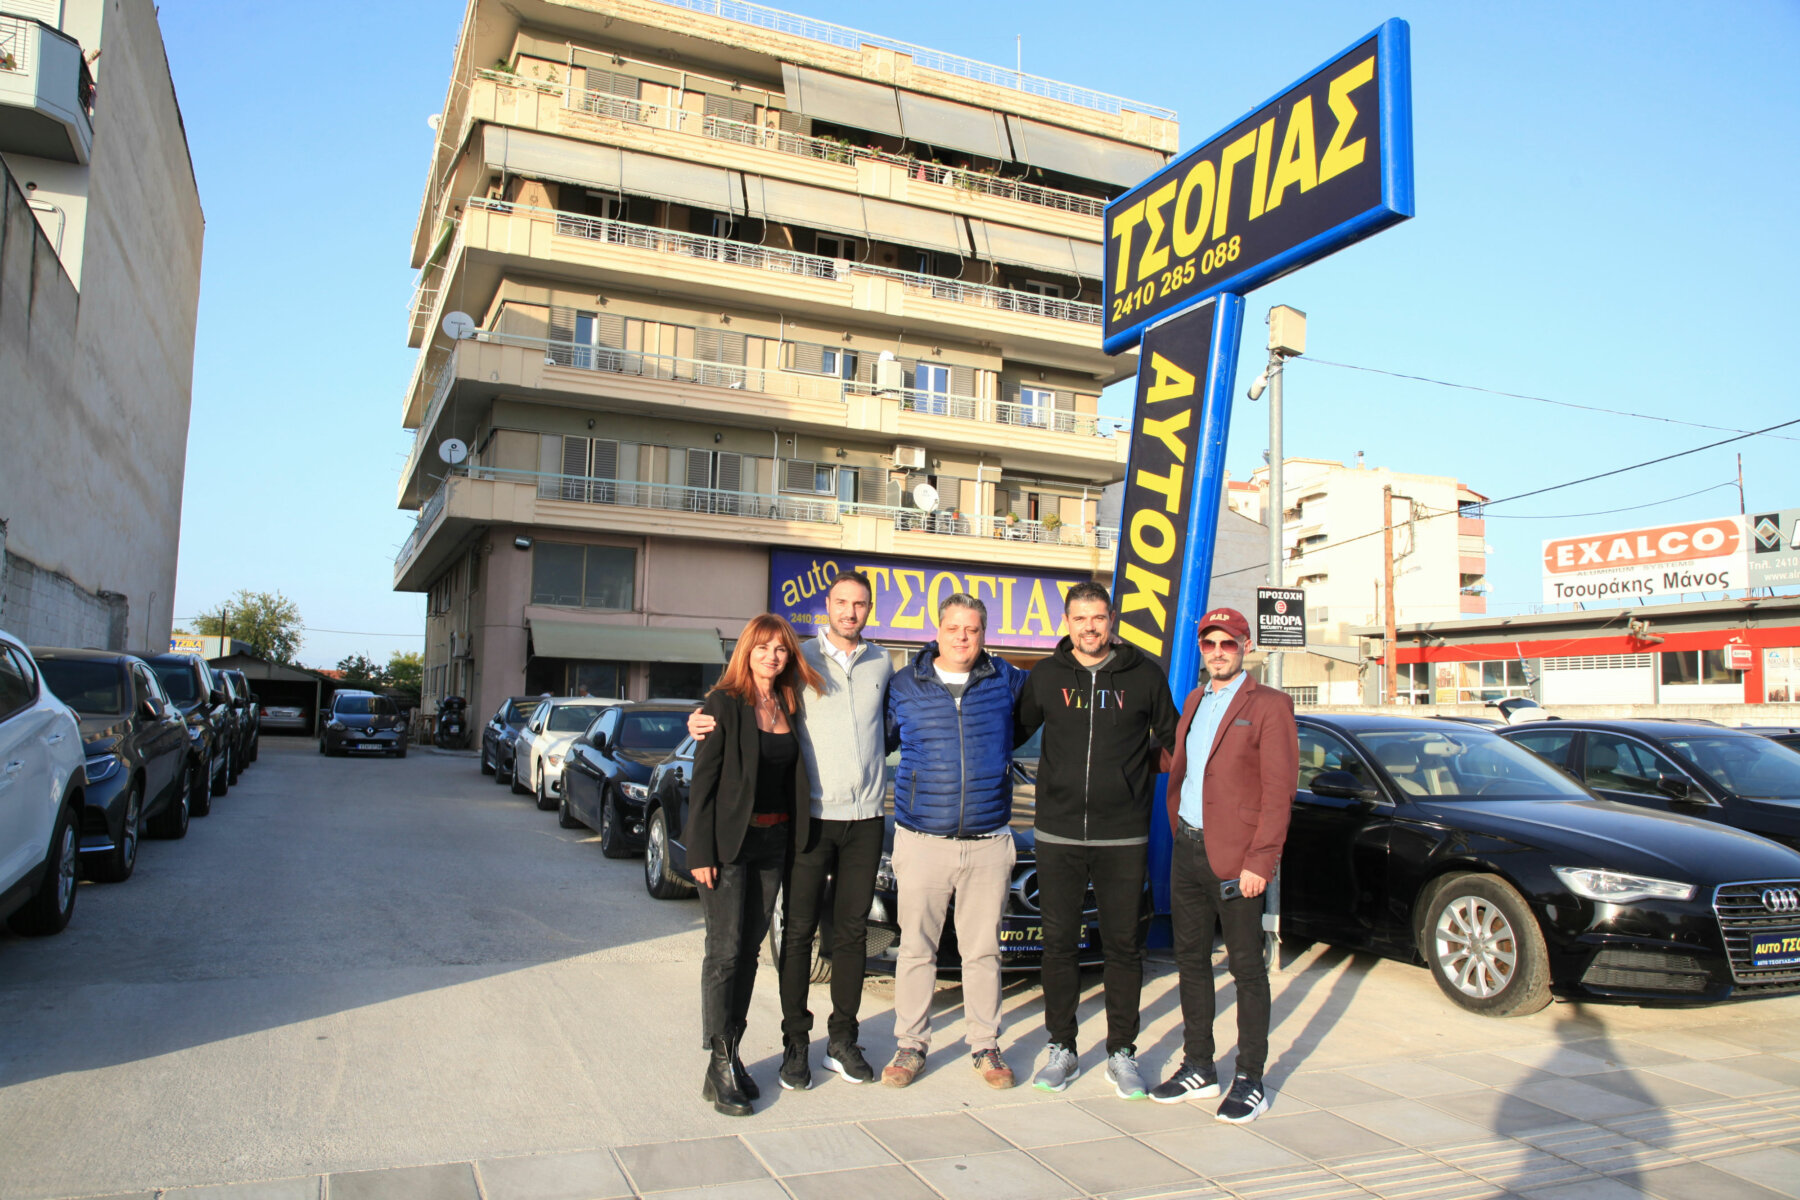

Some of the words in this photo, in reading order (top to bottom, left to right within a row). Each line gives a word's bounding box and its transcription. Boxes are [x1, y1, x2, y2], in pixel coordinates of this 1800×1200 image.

[1111, 55, 1375, 294] ΤΣΟΓΙΑΣ
[1112, 281, 1155, 322] 2410
[1160, 258, 1196, 297] 285
[1201, 235, 1241, 275] 088
[1556, 527, 1725, 567] EXALCO
[1642, 560, 1695, 571] SYSTEMS
[1775, 557, 1798, 568] 2410
[781, 559, 840, 607] auto
[1554, 574, 1653, 599] Τσουράκης
[1663, 570, 1729, 590] Μάνος
[1259, 590, 1303, 600] ΠΡΟΣΟΧΗ
[791, 612, 812, 624] 2410
[814, 614, 830, 625] 28
[1259, 614, 1303, 626] EUROPA
[1061, 687, 1126, 710] VLTN
[999, 930, 1024, 942] UTO
[1755, 942, 1781, 954] AUTO
